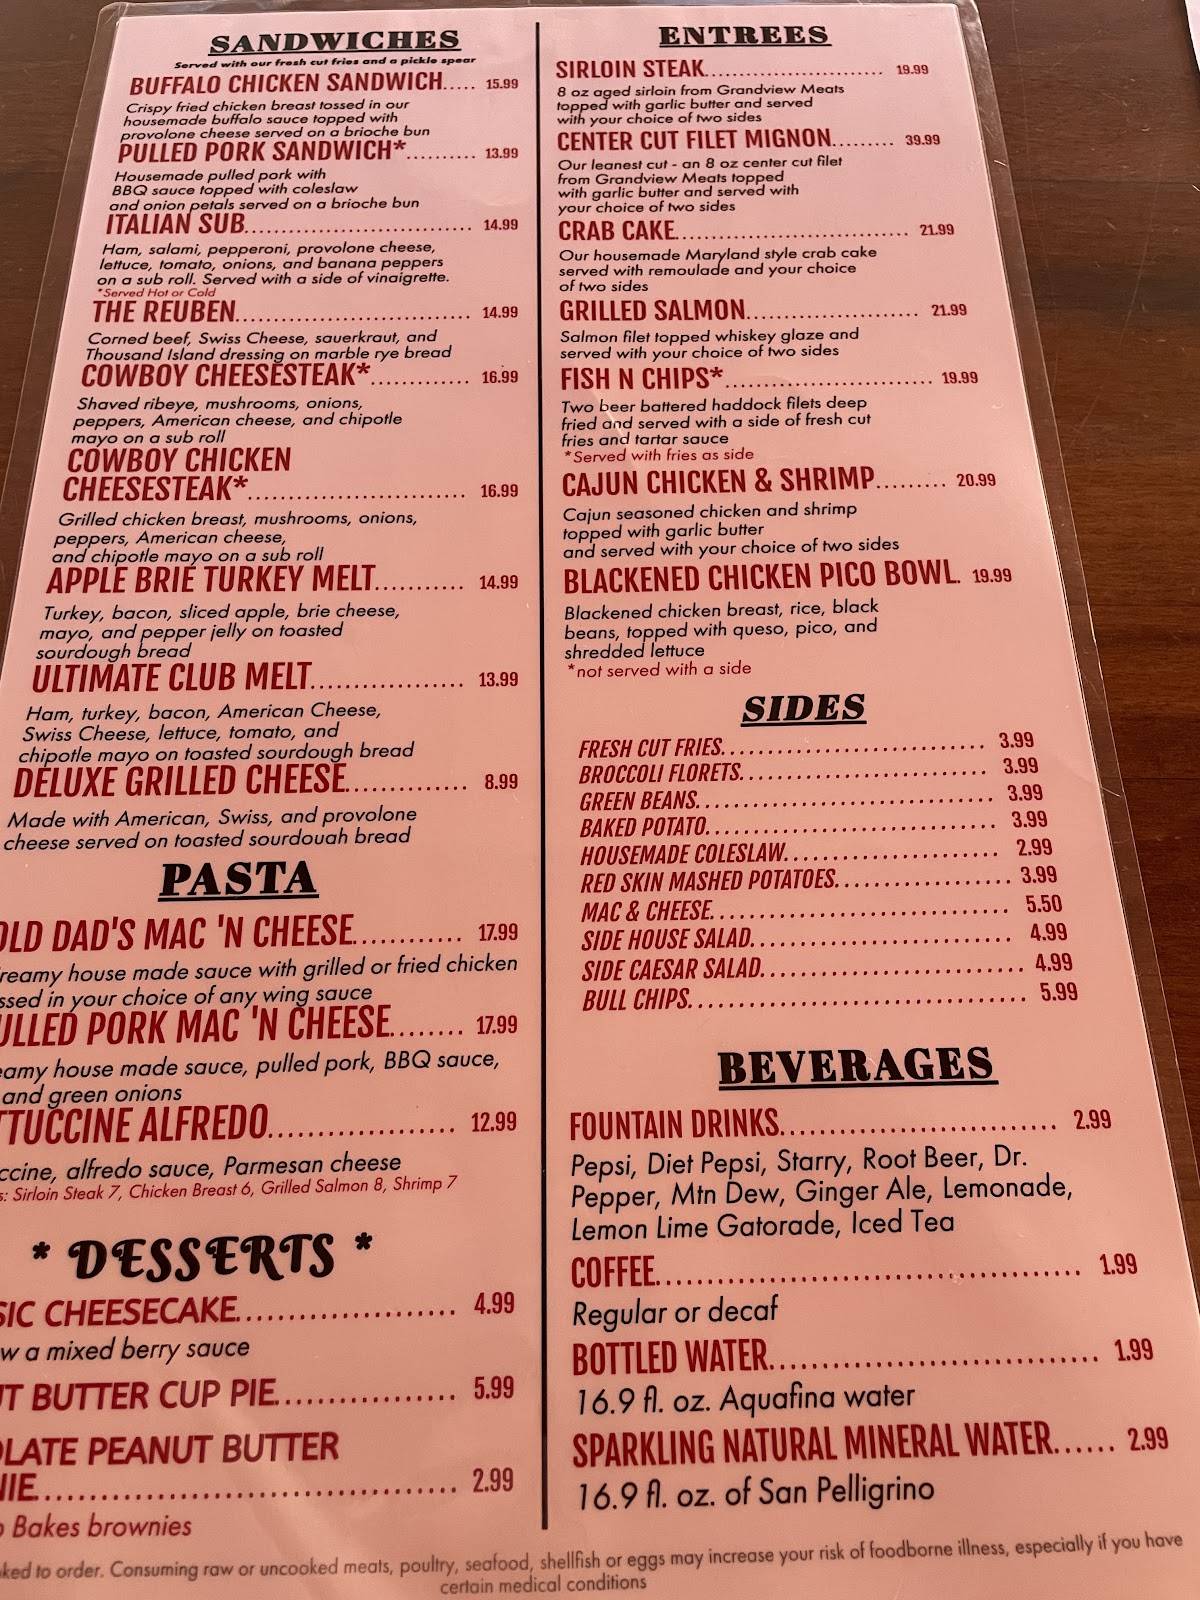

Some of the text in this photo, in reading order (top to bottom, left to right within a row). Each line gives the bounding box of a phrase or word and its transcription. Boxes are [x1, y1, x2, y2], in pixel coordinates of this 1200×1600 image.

[210, 30, 462, 50] SANDWICHES
[658, 25, 828, 44] ENTREES
[174, 60, 218, 69] Served
[221, 60, 247, 68] with
[275, 58, 306, 66] fresh
[331, 57, 359, 66] fries
[362, 56, 387, 65] and
[400, 56, 438, 66] pickle
[441, 58, 476, 66] spear
[896, 64, 929, 75] 19.99
[486, 78, 519, 90] 15.99
[557, 83, 844, 99] 8 oz aged sirloin from Grandview Meats
[123, 112, 398, 127] housemade buffalo sauce topped with
[485, 147, 519, 159] 13.99
[114, 168, 326, 184] Housemade pulled pork with
[484, 218, 518, 231] 14.99
[919, 223, 955, 236] 21.99
[559, 245, 877, 268] Our housemade Maryland style crab cake
[147, 288, 169, 298] Hot
[171, 290, 184, 298] or
[187, 287, 216, 298] Cold
[88, 329, 438, 347] Corned beef, Swiss Cheese, sauerkraut, and
[560, 326, 859, 346] Salmon filet topped whiskey glaze and
[76, 396, 362, 414] Shaved ribeye, mushrooms, onions,
[67, 446, 292, 473] COWBOY CHICKEN
[631, 448, 661, 461] with
[666, 447, 697, 461] fries
[702, 452, 719, 461] as
[723, 446, 754, 460] side
[44, 602, 399, 624] Turkey, bacon, sliced apple, brie cheese,
[606, 661, 661, 678] served
[665, 660, 698, 676] with
[703, 665, 714, 676] a
[719, 659, 752, 675] side
[742, 693, 866, 722] SIDES
[998, 731, 1034, 749] 3.99
[159, 860, 319, 896] PASTA
[1025, 894, 1063, 913] 5.50
[478, 922, 518, 942] 17.99
[718, 1046, 995, 1084] BEVERAGES
[471, 1110, 517, 1132] 12.99
[1073, 1108, 1112, 1130] 2.99
[571, 1144, 1027, 1183] Pepsi, Diet Pepsi, Starry, Root Beer, Dr.
[12, 1174, 458, 1202] Sirloin Steak 7, Chicken Breast 6, Grilled Salmon 8, Shrimp 7
[67, 1232, 335, 1283] DESSERTS
[1099, 1252, 1138, 1276] 1.99
[474, 1291, 515, 1315] 4.99
[573, 1293, 779, 1333] Regular or decaf
[25, 1336, 250, 1366] a mixed berry sauce
[88, 1430, 340, 1466] PEANUT BUTTER
[472, 1467, 514, 1493] 2.99
[580, 1473, 934, 1510] 16.9 fl. oz. of San Pelligrino
[12, 1512, 192, 1538] Bakes brownies
[35, 1530, 1184, 1582] to order. Consuming raw or uncooked meats, poultry, seafood, shellfish or eggs may increase your risk of foodborne illness, especially if you have
[440, 1572, 647, 1595] certain medical conditions
